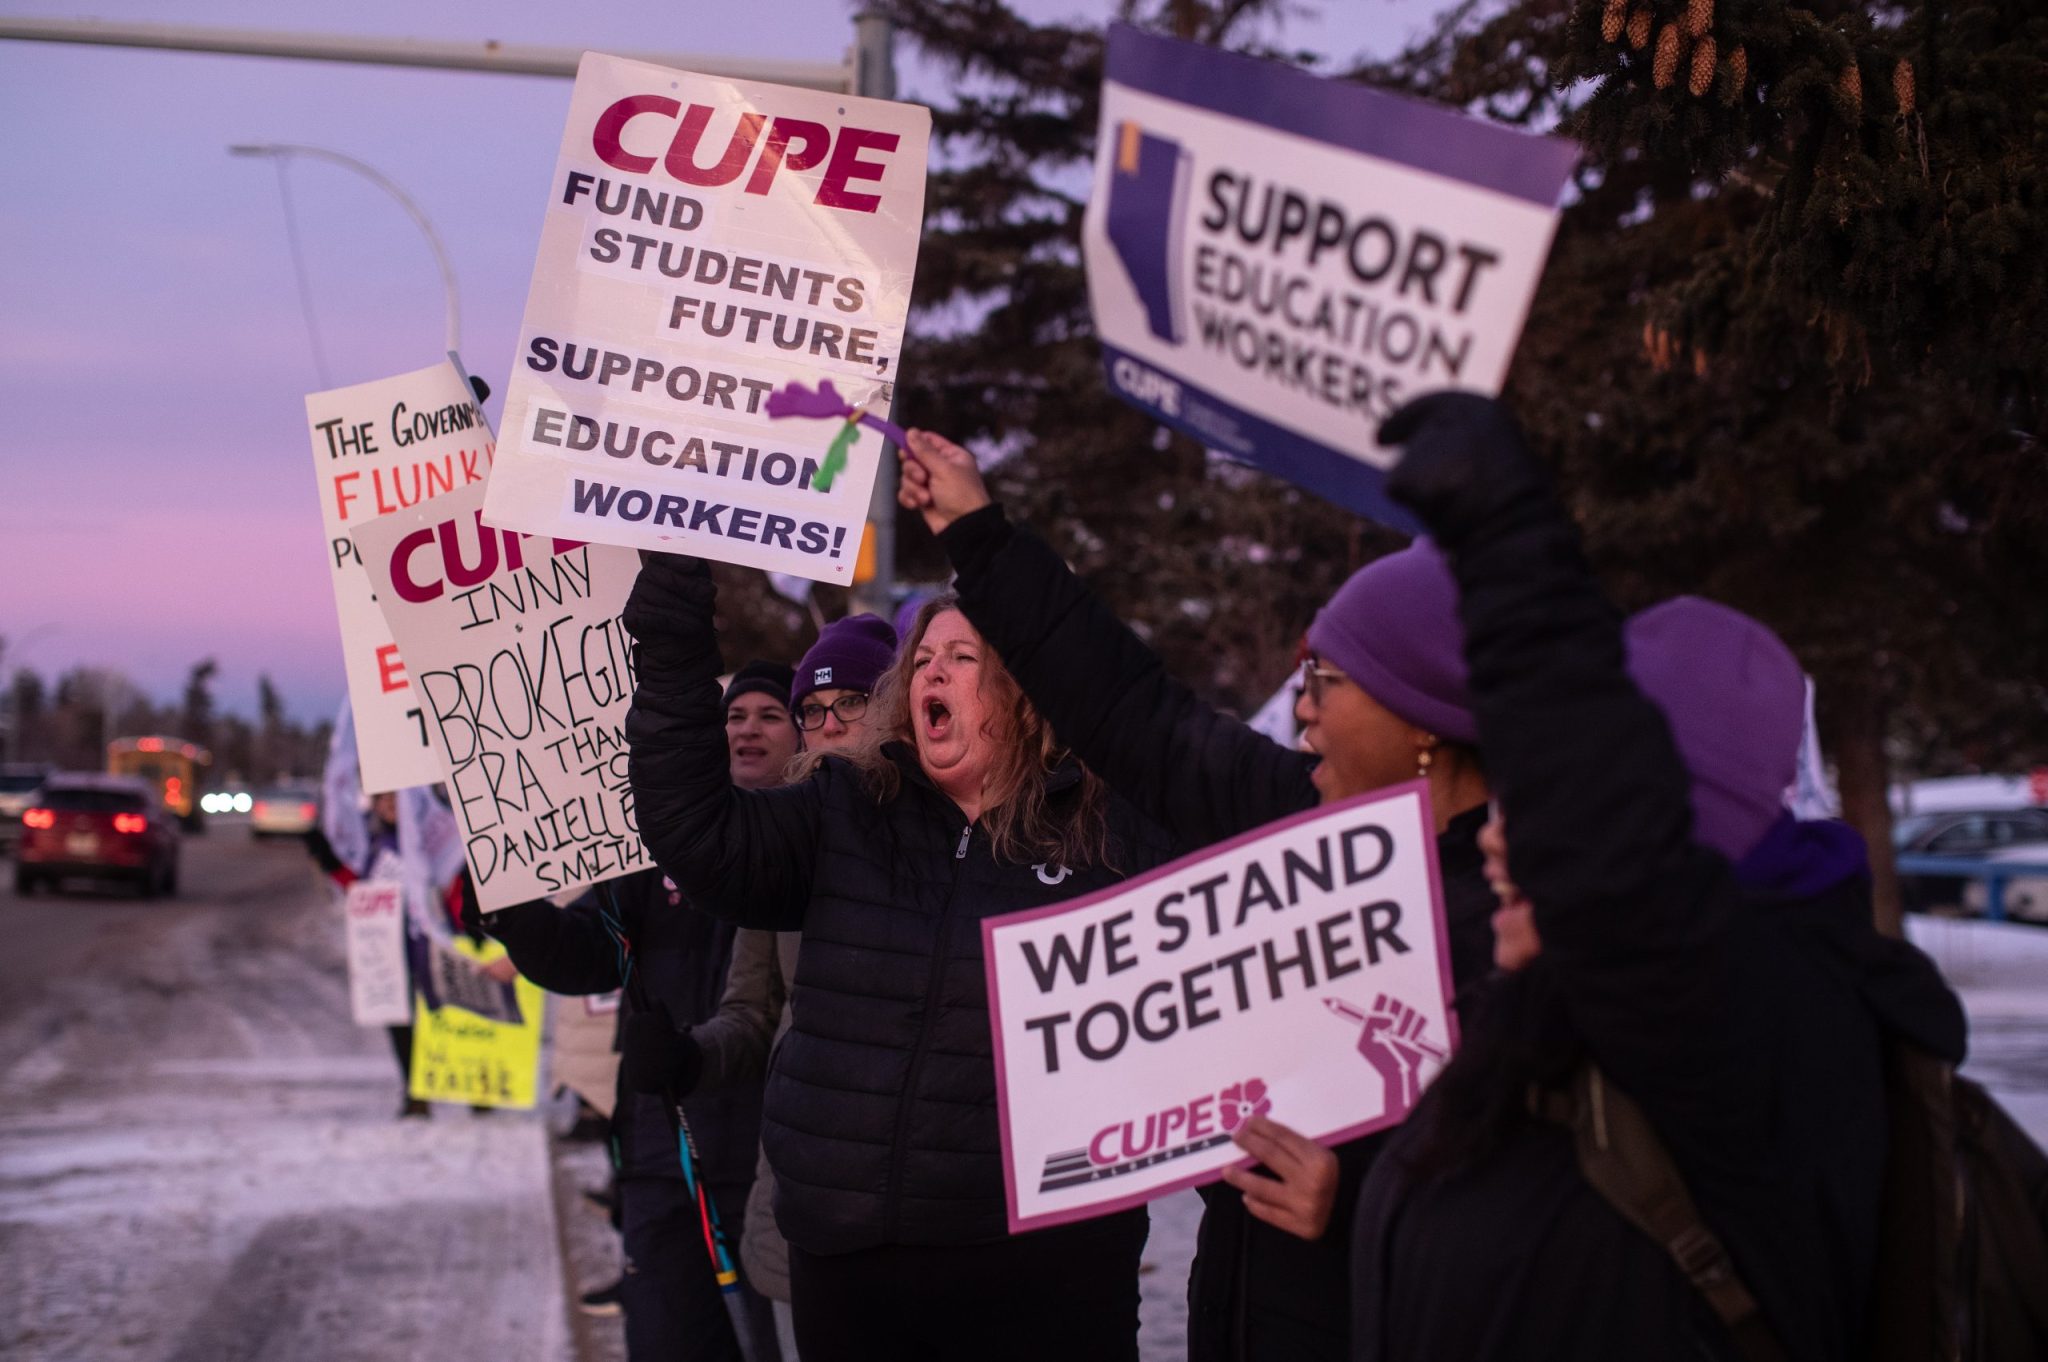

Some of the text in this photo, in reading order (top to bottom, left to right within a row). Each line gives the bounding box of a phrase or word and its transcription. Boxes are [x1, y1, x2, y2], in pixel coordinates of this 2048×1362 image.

[592, 95, 900, 213] CUPE
[563, 171, 703, 231] FUND
[1203, 171, 1497, 313] SUPPORT
[590, 228, 865, 312] STUDENTS
[1195, 246, 1471, 376] EDUCATION
[527, 337, 773, 414] SUPPORT
[669, 296, 889, 376] FUTURE,
[1194, 303, 1403, 421] WORKERS
[315, 417, 379, 459] THE
[390, 508, 592, 603] CU
[574, 479, 846, 558] WORKERS!
[815, 669, 831, 680] HH
[452, 748, 553, 835] ERA
[467, 791, 641, 886] DANIELLE
[1020, 824, 1395, 994] WE STAND
[1025, 900, 1412, 1074] TOGETHER
[1088, 1094, 1214, 1166] CUPE
